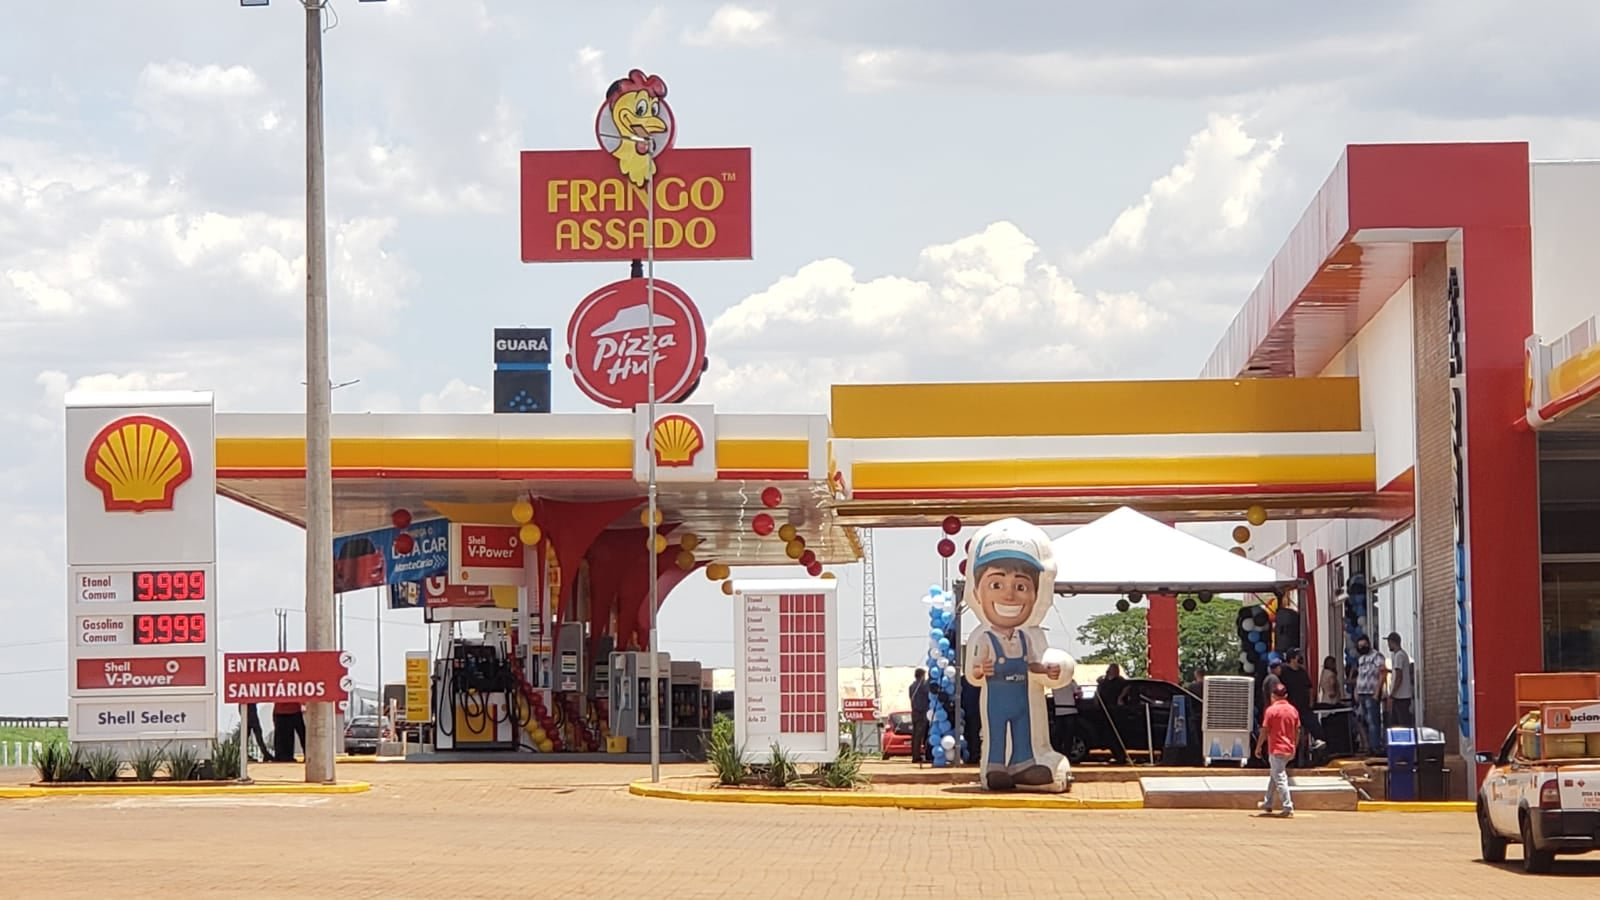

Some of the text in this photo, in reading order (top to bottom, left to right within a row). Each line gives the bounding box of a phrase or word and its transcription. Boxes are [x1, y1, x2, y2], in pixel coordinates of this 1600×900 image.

[548, 172, 736, 213] FRANGO TM
[556, 217, 716, 250] ASSADO
[496, 337, 549, 351] GUARÁ
[593, 332, 677, 371] Pizza
[606, 352, 668, 385] Hut
[422, 537, 447, 553] CAR
[468, 536, 486, 545] Shell
[468, 545, 514, 558] V-Power
[82, 576, 111, 588] Etanol
[137, 572, 204, 600] 9.999
[82, 590, 117, 600] Comum
[82, 619, 124, 630] Gasolina
[138, 615, 205, 643] 9.999
[82, 632, 117, 643] Comum
[104, 662, 131, 672] Shell
[227, 658, 300, 673] ENTRADA
[105, 672, 174, 686] V-Power
[228, 679, 325, 698] SANITÁRIOS
[98, 709, 187, 725] Shell Select
[1564, 712, 1600, 722] Lucian
